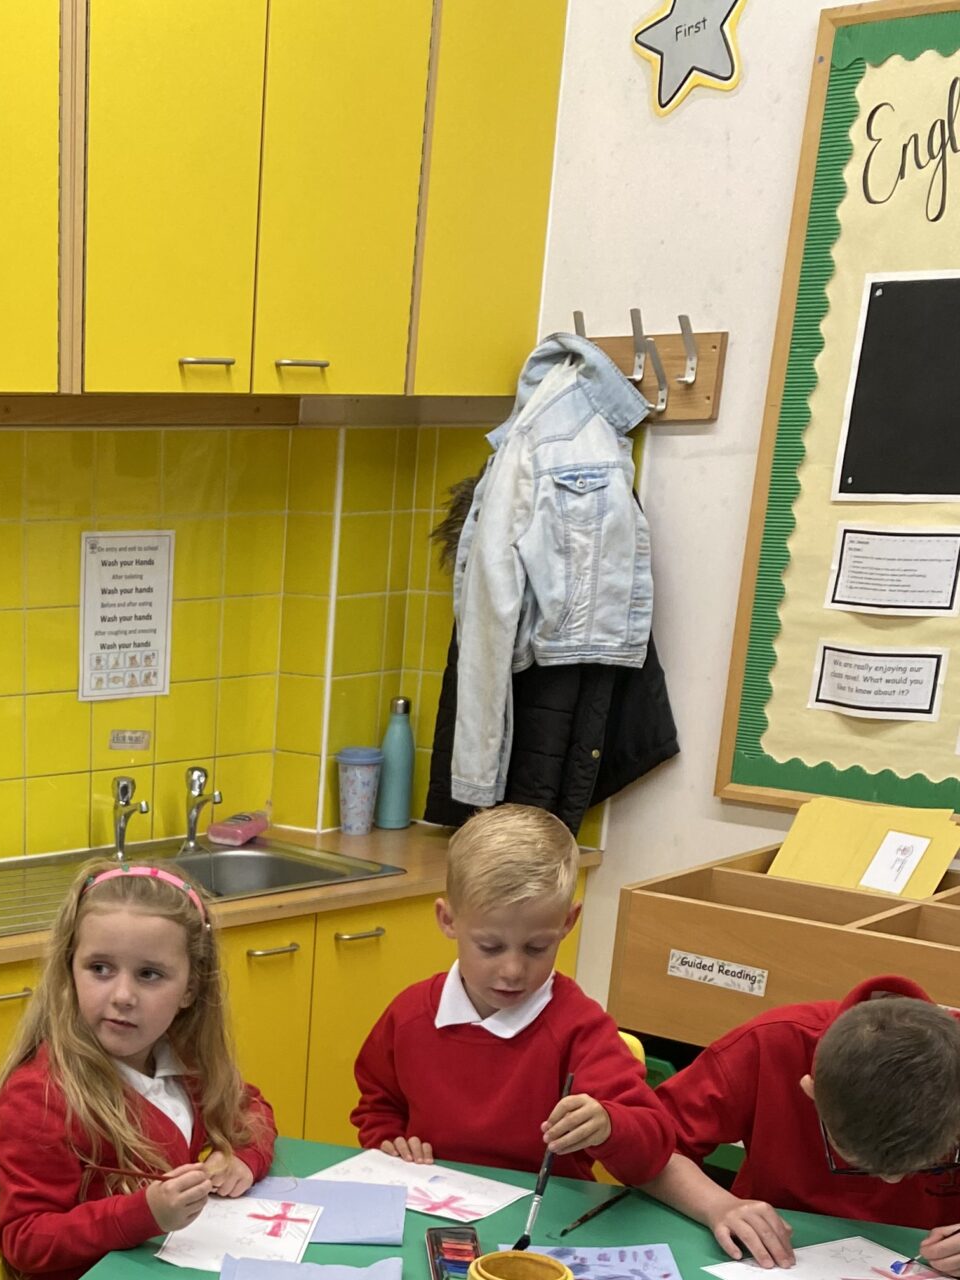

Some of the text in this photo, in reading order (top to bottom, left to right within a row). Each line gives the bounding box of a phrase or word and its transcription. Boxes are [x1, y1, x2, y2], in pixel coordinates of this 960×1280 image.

[675, 17, 708, 42] First
[120, 560, 134, 568] your
[135, 558, 155, 566] Hands
[120, 588, 134, 596] your
[100, 615, 118, 623] Wash
[134, 613, 153, 621] hands
[99, 640, 151, 650] Wash your hands
[854, 663, 872, 672] really
[874, 666, 907, 674] enjoying
[863, 676, 883, 684] What
[885, 677, 908, 685] would
[909, 678, 924, 687] you
[855, 687, 872, 695] know
[874, 688, 896, 696] about
[897, 688, 910, 696] it?
[681, 957, 757, 984] Guided Reading
